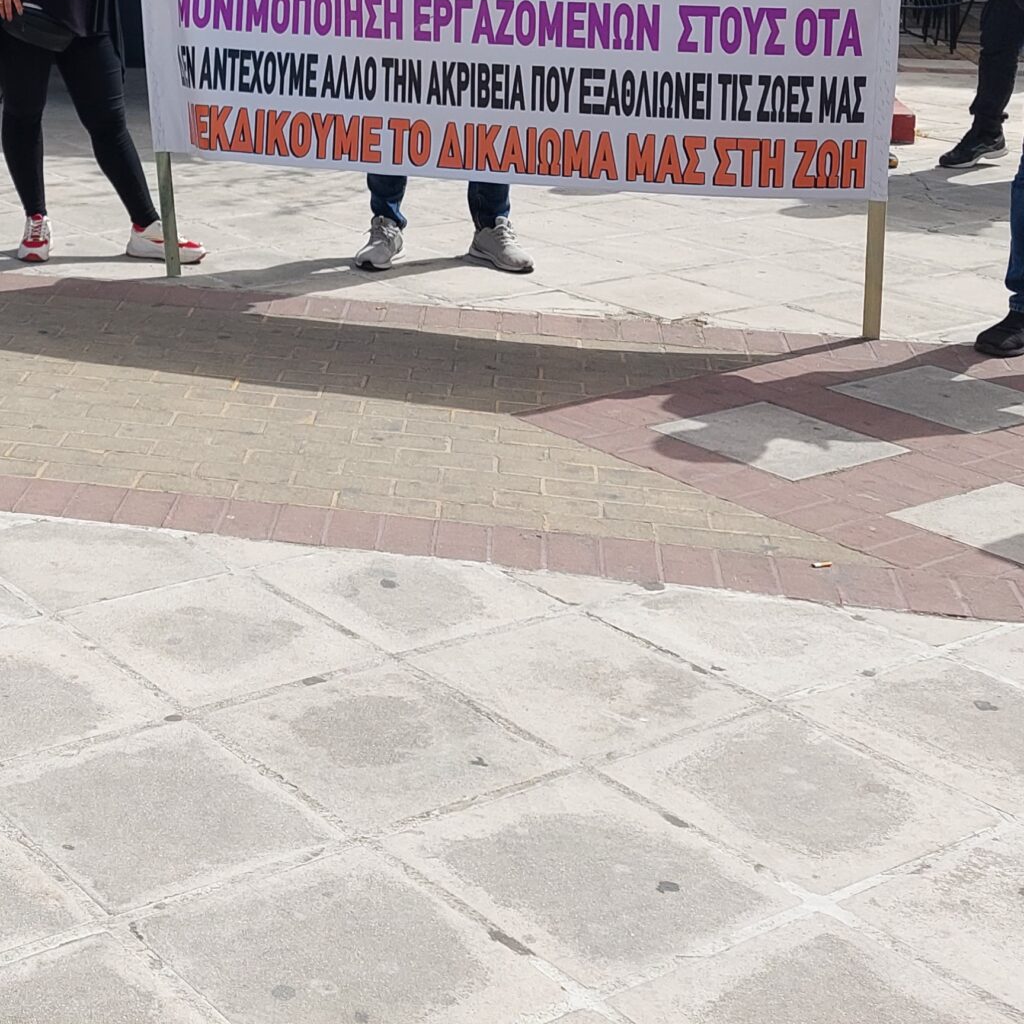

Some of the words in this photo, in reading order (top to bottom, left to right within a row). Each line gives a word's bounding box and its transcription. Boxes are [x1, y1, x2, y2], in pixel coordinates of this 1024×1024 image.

[677, 5, 787, 55] ΣΤΟΥΣ
[795, 8, 862, 57] ΟΤΑ
[199, 48, 318, 97] ΑΝΤΕΧΟΥΜΕ
[321, 55, 376, 101] ΑΛΛΟ
[382, 58, 422, 105] ΤΗΝ
[427, 60, 525, 111] ΑΚΡΙΒΕΙΑ
[531, 66, 574, 113] ΠΟΥ
[579, 68, 712, 120] ΕΞΑΘΛΙΩΝΕΙ
[718, 73, 752, 121] ΤΙΣ
[757, 75, 814, 123] ΖΩΕΣ
[819, 75, 867, 124] ΜΑΣ
[388, 118, 431, 166] ΤΟ
[438, 123, 617, 180] ΔΙΚΑΙΩΜΑ
[627, 133, 707, 184] ΜΑΣ
[713, 137, 785, 188] ΣΤΗ
[793, 139, 867, 190] ΖΩΗ
